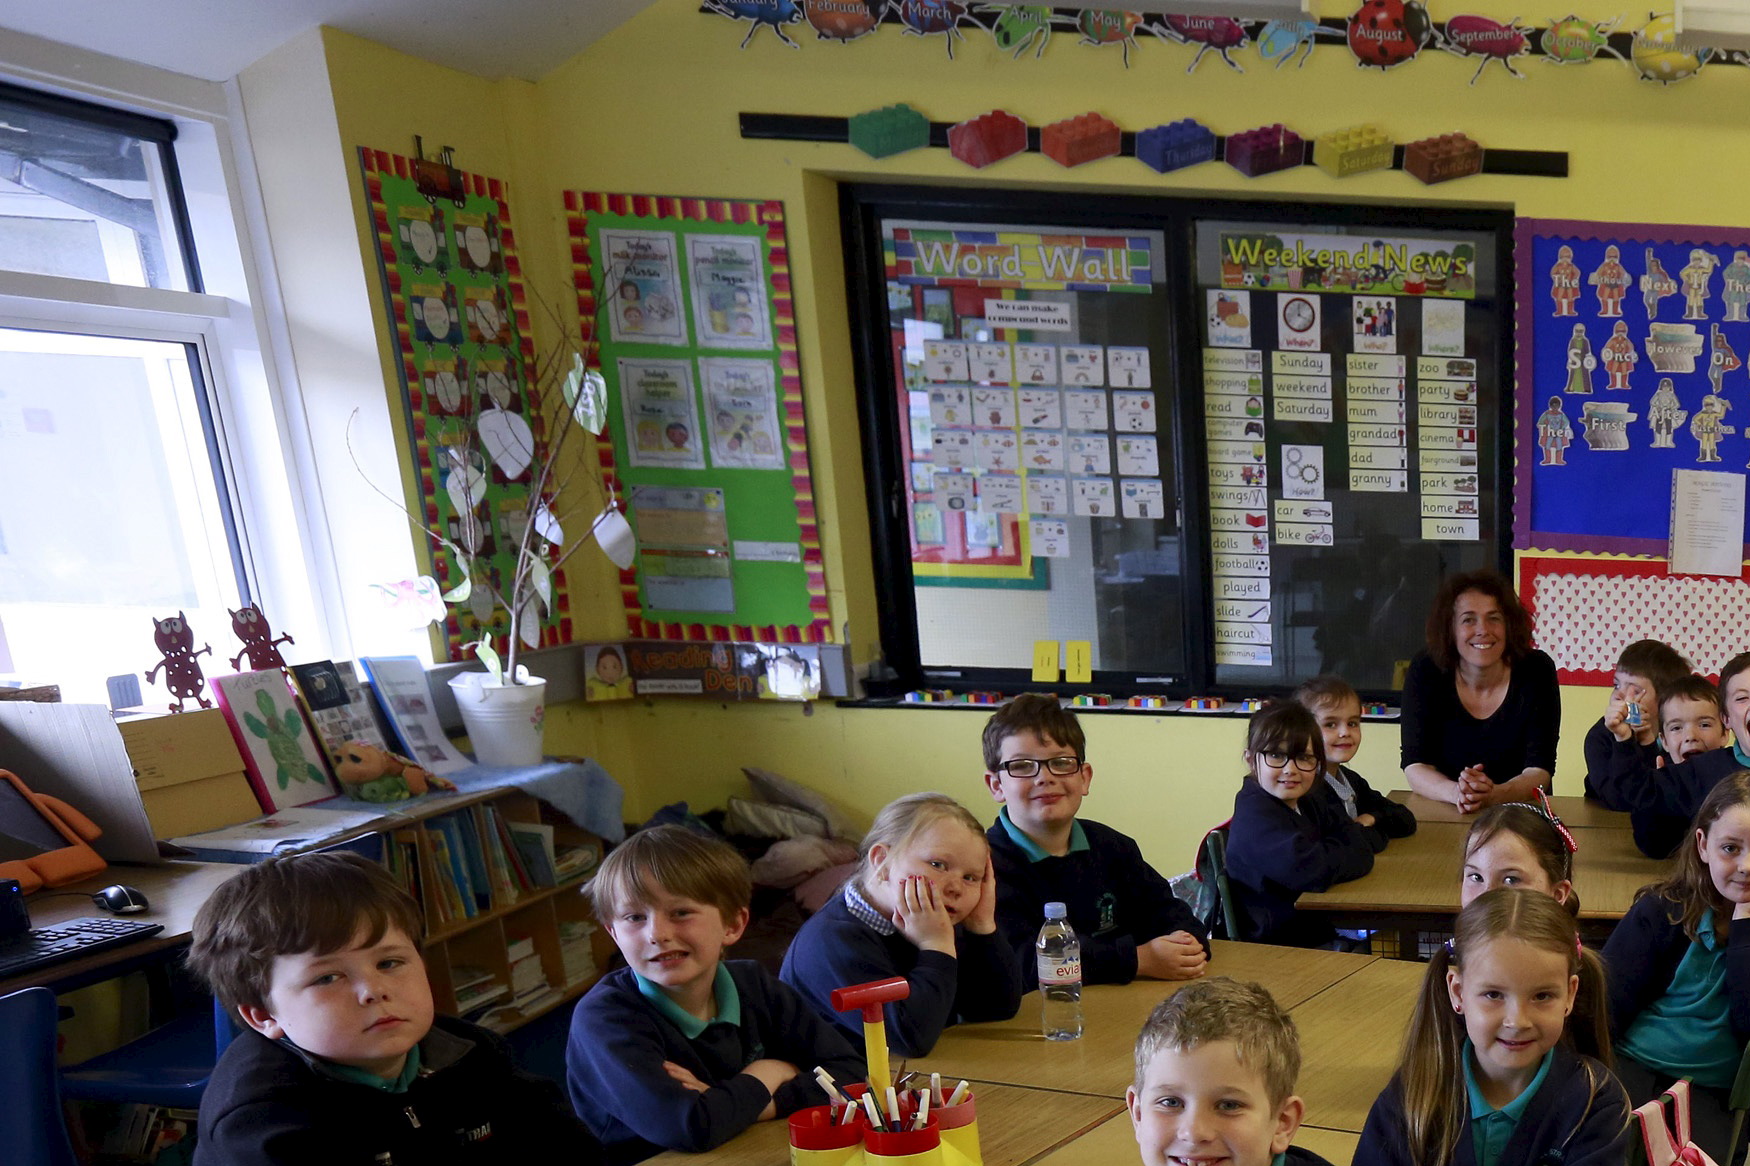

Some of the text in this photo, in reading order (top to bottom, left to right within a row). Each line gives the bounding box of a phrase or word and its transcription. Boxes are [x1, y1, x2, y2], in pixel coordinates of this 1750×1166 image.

[808, 2, 870, 18] February
[908, 1, 951, 20] March
[1010, 8, 1043, 25] April
[1091, 11, 1120, 29] May
[1183, 18, 1215, 29] June
[1356, 27, 1403, 45] August
[1452, 29, 1516, 45] September
[1546, 31, 1597, 50] October
[1165, 143, 1213, 164] Thursday
[1341, 151, 1392, 171] Saturday
[1433, 158, 1480, 178] Sunday
[916, 241, 1132, 280] Word Wall
[1227, 238, 1468, 275] Weekend News
[1553, 274, 1579, 289] The
[1640, 279, 1677, 293] Next
[1693, 274, 1708, 292] If
[1029, 304, 1058, 312] make
[1040, 316, 1068, 325] words
[1285, 337, 1314, 348] When?
[1203, 355, 1244, 366] television
[1280, 354, 1323, 372] Sunday
[1568, 350, 1596, 370] So
[1602, 349, 1638, 364] Once
[1713, 352, 1733, 366] On
[1349, 360, 1378, 370] sister
[1419, 364, 1439, 373] zoo
[1205, 377, 1246, 390] shopping
[1277, 382, 1327, 394] weekend
[1349, 384, 1390, 395] brother
[1419, 385, 1450, 400] party
[1206, 401, 1231, 412] read
[1277, 403, 1329, 418] Saturday
[1349, 408, 1377, 417] mum
[1420, 409, 1457, 423] library
[1650, 409, 1687, 424] After
[1539, 425, 1573, 438] Then
[1591, 418, 1625, 433] First
[1713, 423, 1735, 434] then
[1349, 428, 1397, 442] grandad
[1420, 432, 1454, 443] cinema
[1351, 452, 1373, 463] dad
[1420, 455, 1460, 466] fairground
[1211, 468, 1234, 480] toys
[1352, 475, 1392, 488] granny
[1422, 477, 1447, 491] park
[1210, 490, 1248, 502] swings
[1291, 487, 1316, 497] How?
[1277, 506, 1294, 515] car
[1422, 502, 1453, 513] home
[1212, 515, 1240, 526] book
[1277, 529, 1300, 540] bike
[1436, 524, 1465, 534] town
[1213, 539, 1238, 549] dolls
[1214, 558, 1255, 571] football
[1223, 582, 1260, 596] played
[1216, 606, 1241, 617] slide
[1217, 628, 1255, 639] haircut
[631, 645, 733, 673] Reading
[1216, 650, 1256, 660] swimming
[705, 669, 753, 691] Den
[1057, 965, 1082, 977] evia
